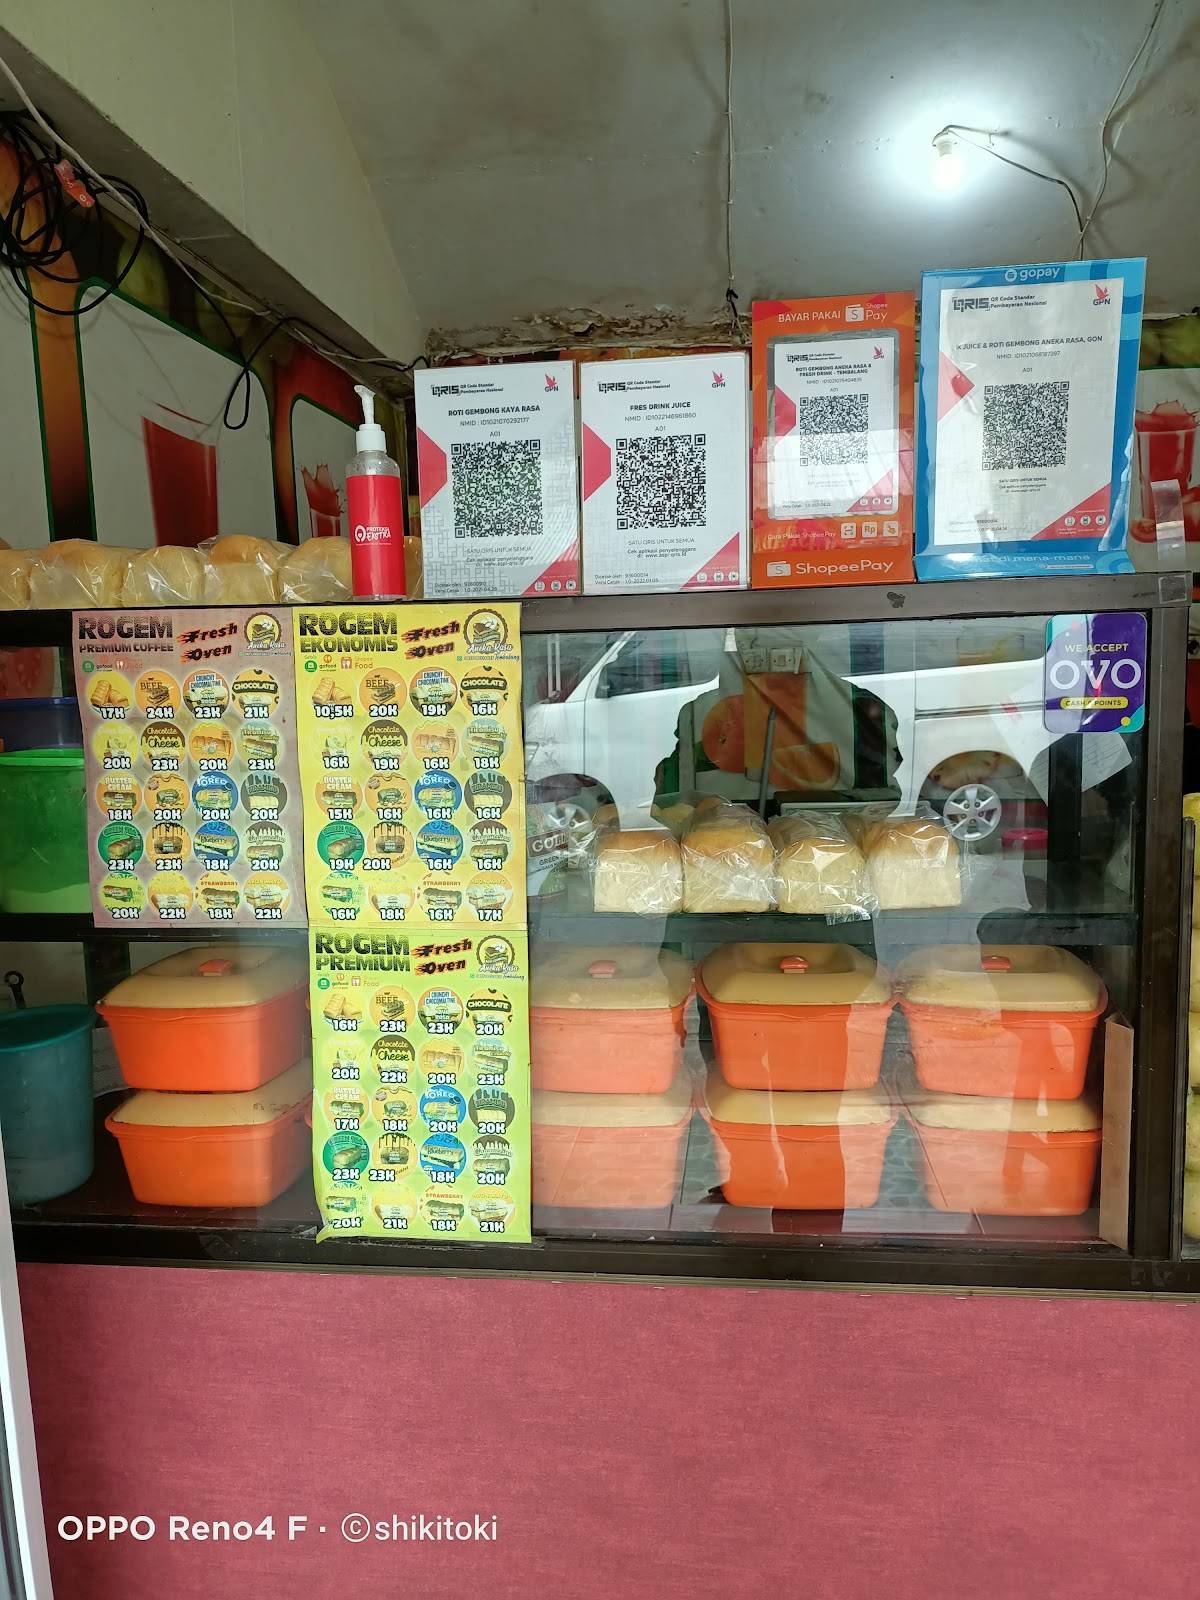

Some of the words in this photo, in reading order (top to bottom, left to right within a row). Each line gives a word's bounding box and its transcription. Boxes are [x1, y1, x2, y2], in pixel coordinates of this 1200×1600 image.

[1020, 267, 1060, 281] gopay
[953, 298, 990, 312] QRIS
[779, 313, 809, 323] BAYAR
[812, 311, 841, 320] PAKAI
[866, 310, 887, 322] Pay
[1006, 339, 1039, 347] GEMBONG
[432, 385, 460, 397] QRIS
[599, 382, 626, 393] QRIS
[864, 525, 875, 534] Rp
[796, 560, 893, 576] ShopeePay
[78, 617, 173, 640] ROGEM
[300, 612, 397, 636] ROGEM
[187, 623, 238, 643] Fresh
[412, 621, 460, 641] Fresh
[80, 644, 131, 653] PREMIUM
[133, 643, 174, 652] COFFEE
[301, 637, 398, 653] EKONOMIS
[414, 642, 454, 657] Oven
[1087, 643, 1129, 652] ACCEPT
[190, 644, 232, 660] Oven
[1050, 659, 1141, 689] OVO
[140, 681, 163, 691] BEEF
[234, 682, 276, 691] CHOCOLATE
[366, 679, 387, 688] BEEF
[462, 679, 505, 688] CHOCOLATE
[100, 707, 125, 719] 17K
[146, 707, 174, 719] 24K
[195, 707, 221, 719] 23K
[244, 706, 269, 718] 21K
[314, 705, 353, 719] 10,5K
[369, 704, 398, 717] 20K
[421, 704, 448, 716] 19K
[472, 703, 497, 716] 16K
[148, 738, 180, 749] Cheese
[369, 738, 402, 748] Cheese
[104, 757, 131, 769] 20K
[152, 759, 179, 771] 23K
[199, 759, 227, 770] 20K
[248, 759, 275, 771] 23K
[323, 756, 350, 769] 16K
[373, 757, 400, 770] 19K
[424, 757, 449, 770] 16K
[474, 756, 500, 769] 18K
[200, 776, 226, 786] OREO
[423, 777, 450, 785] OREO
[108, 809, 132, 821] 18K
[154, 809, 182, 821] 20K
[202, 809, 230, 821] 20K
[251, 809, 279, 821] 20K
[328, 808, 353, 820] 15K
[377, 808, 402, 820] 16K
[426, 808, 452, 820] 16K
[476, 807, 501, 820] 16K
[108, 859, 135, 871] 23K
[156, 859, 182, 871] 23K
[204, 859, 229, 871] 18K
[251, 859, 279, 871] 20K
[329, 858, 355, 870] 19K
[363, 858, 392, 870] 20K
[427, 858, 453, 870] 16K
[477, 858, 502, 870] 16K
[112, 907, 139, 919] 20K
[160, 907, 186, 919] 22K
[208, 907, 233, 919] 18K
[255, 907, 282, 920] 22K
[331, 908, 356, 920] 16K
[380, 908, 406, 920] 18K
[428, 908, 454, 921] 16K
[478, 909, 503, 921] 17K
[316, 932, 410, 956] ROGEM
[423, 938, 472, 958] Fresh
[316, 955, 411, 972] PREMIUM
[426, 960, 466, 975] Oven
[376, 996, 397, 1004] BEEF
[468, 1000, 509, 1010] CHOCOLATE
[332, 1019, 358, 1032] 16K
[380, 1020, 406, 1032] 23K
[427, 1022, 454, 1035] 23K
[476, 1023, 504, 1035] 20K
[378, 1040, 408, 1048] Chocolate
[378, 1051, 410, 1061] Cheese
[332, 1067, 360, 1080] 20K
[380, 1071, 407, 1084] 22K
[428, 1072, 457, 1085] 20K
[478, 1073, 505, 1085] 23K
[428, 1090, 455, 1098] OREO
[334, 1118, 359, 1131] 17K
[383, 1119, 407, 1131] 18K
[429, 1120, 458, 1133] 20K
[478, 1122, 506, 1134] 20K
[332, 1168, 360, 1181] 23K
[369, 1169, 396, 1182] 23K
[430, 1171, 455, 1183] 18K
[478, 1172, 505, 1184] 20K
[332, 1217, 361, 1229] 20K
[383, 1218, 407, 1230] 21K
[431, 1219, 456, 1232] 18K
[480, 1220, 505, 1233] 21K
